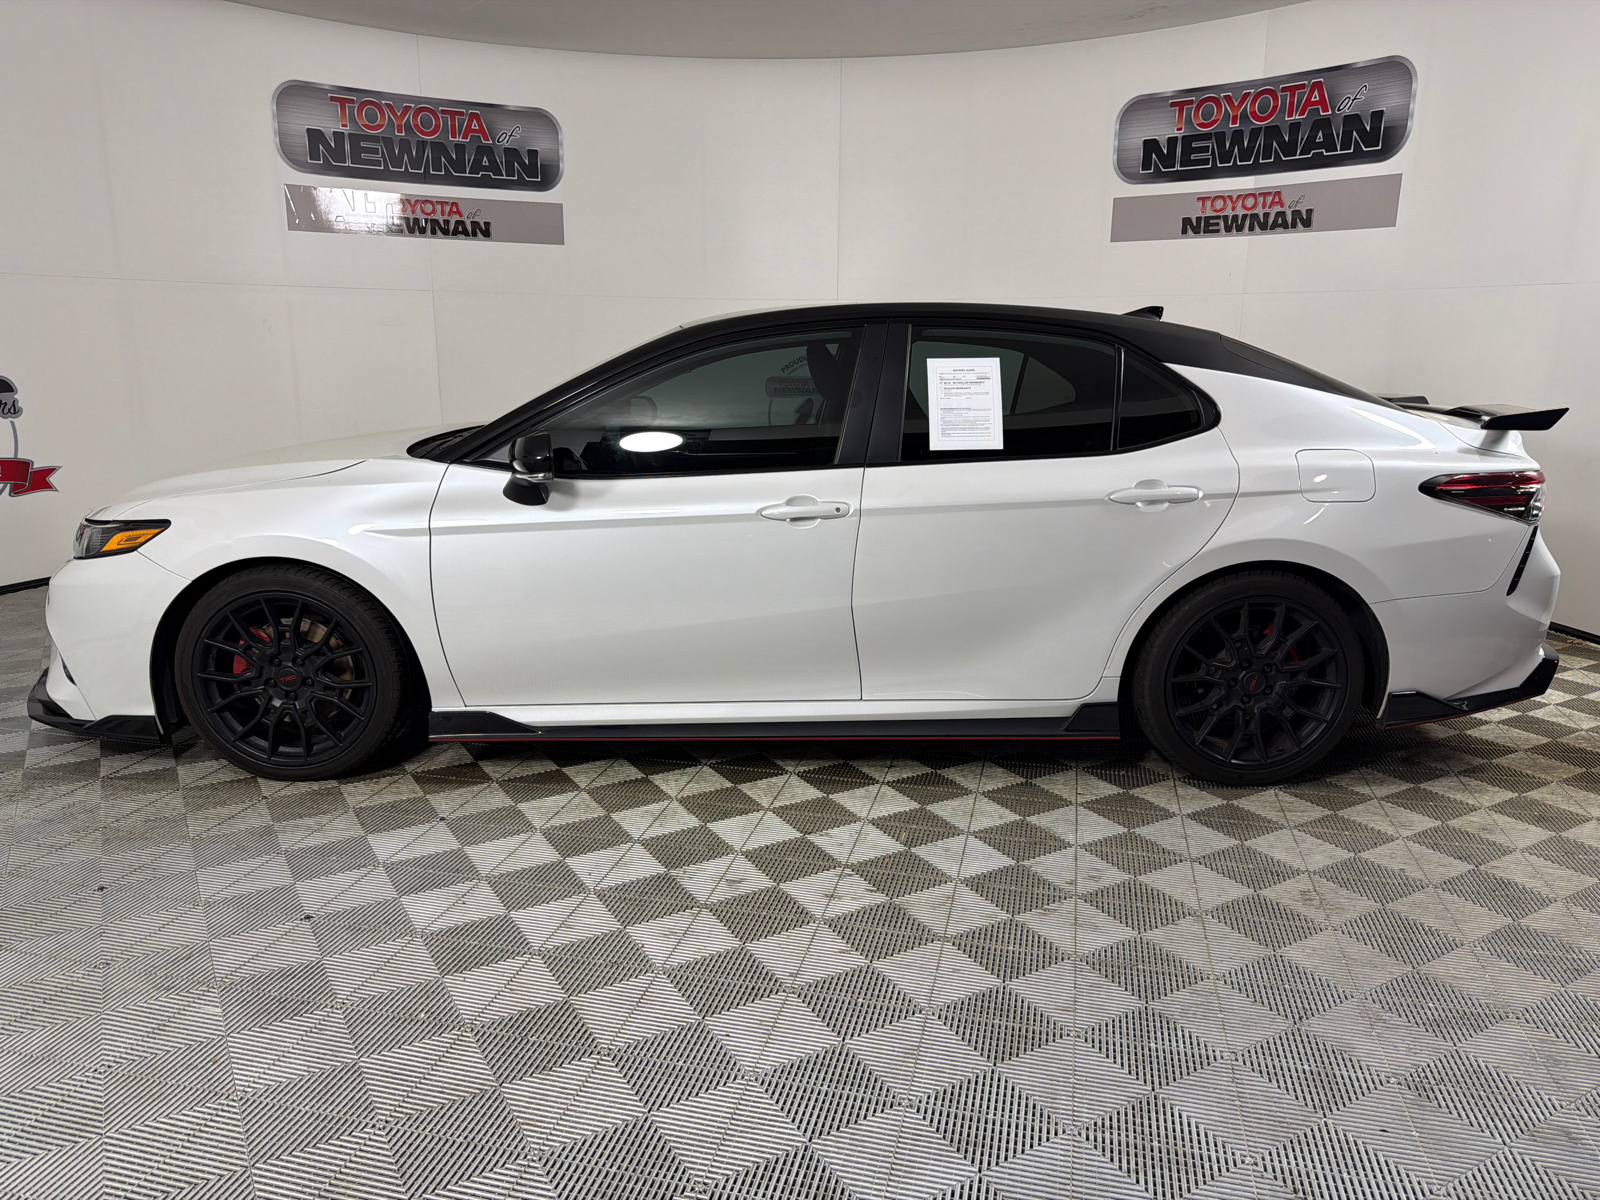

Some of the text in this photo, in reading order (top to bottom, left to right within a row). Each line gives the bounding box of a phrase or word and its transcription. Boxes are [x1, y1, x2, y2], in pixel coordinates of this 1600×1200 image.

[329, 94, 521, 145] TOYOTA of
[1169, 78, 1368, 132] TOYOTA of
[305, 127, 541, 181] NEWNAN
[1140, 108, 1386, 173] NEWNAN
[1180, 208, 1314, 236] NEWNAN
[1196, 190, 1306, 214] TOYOTA of
